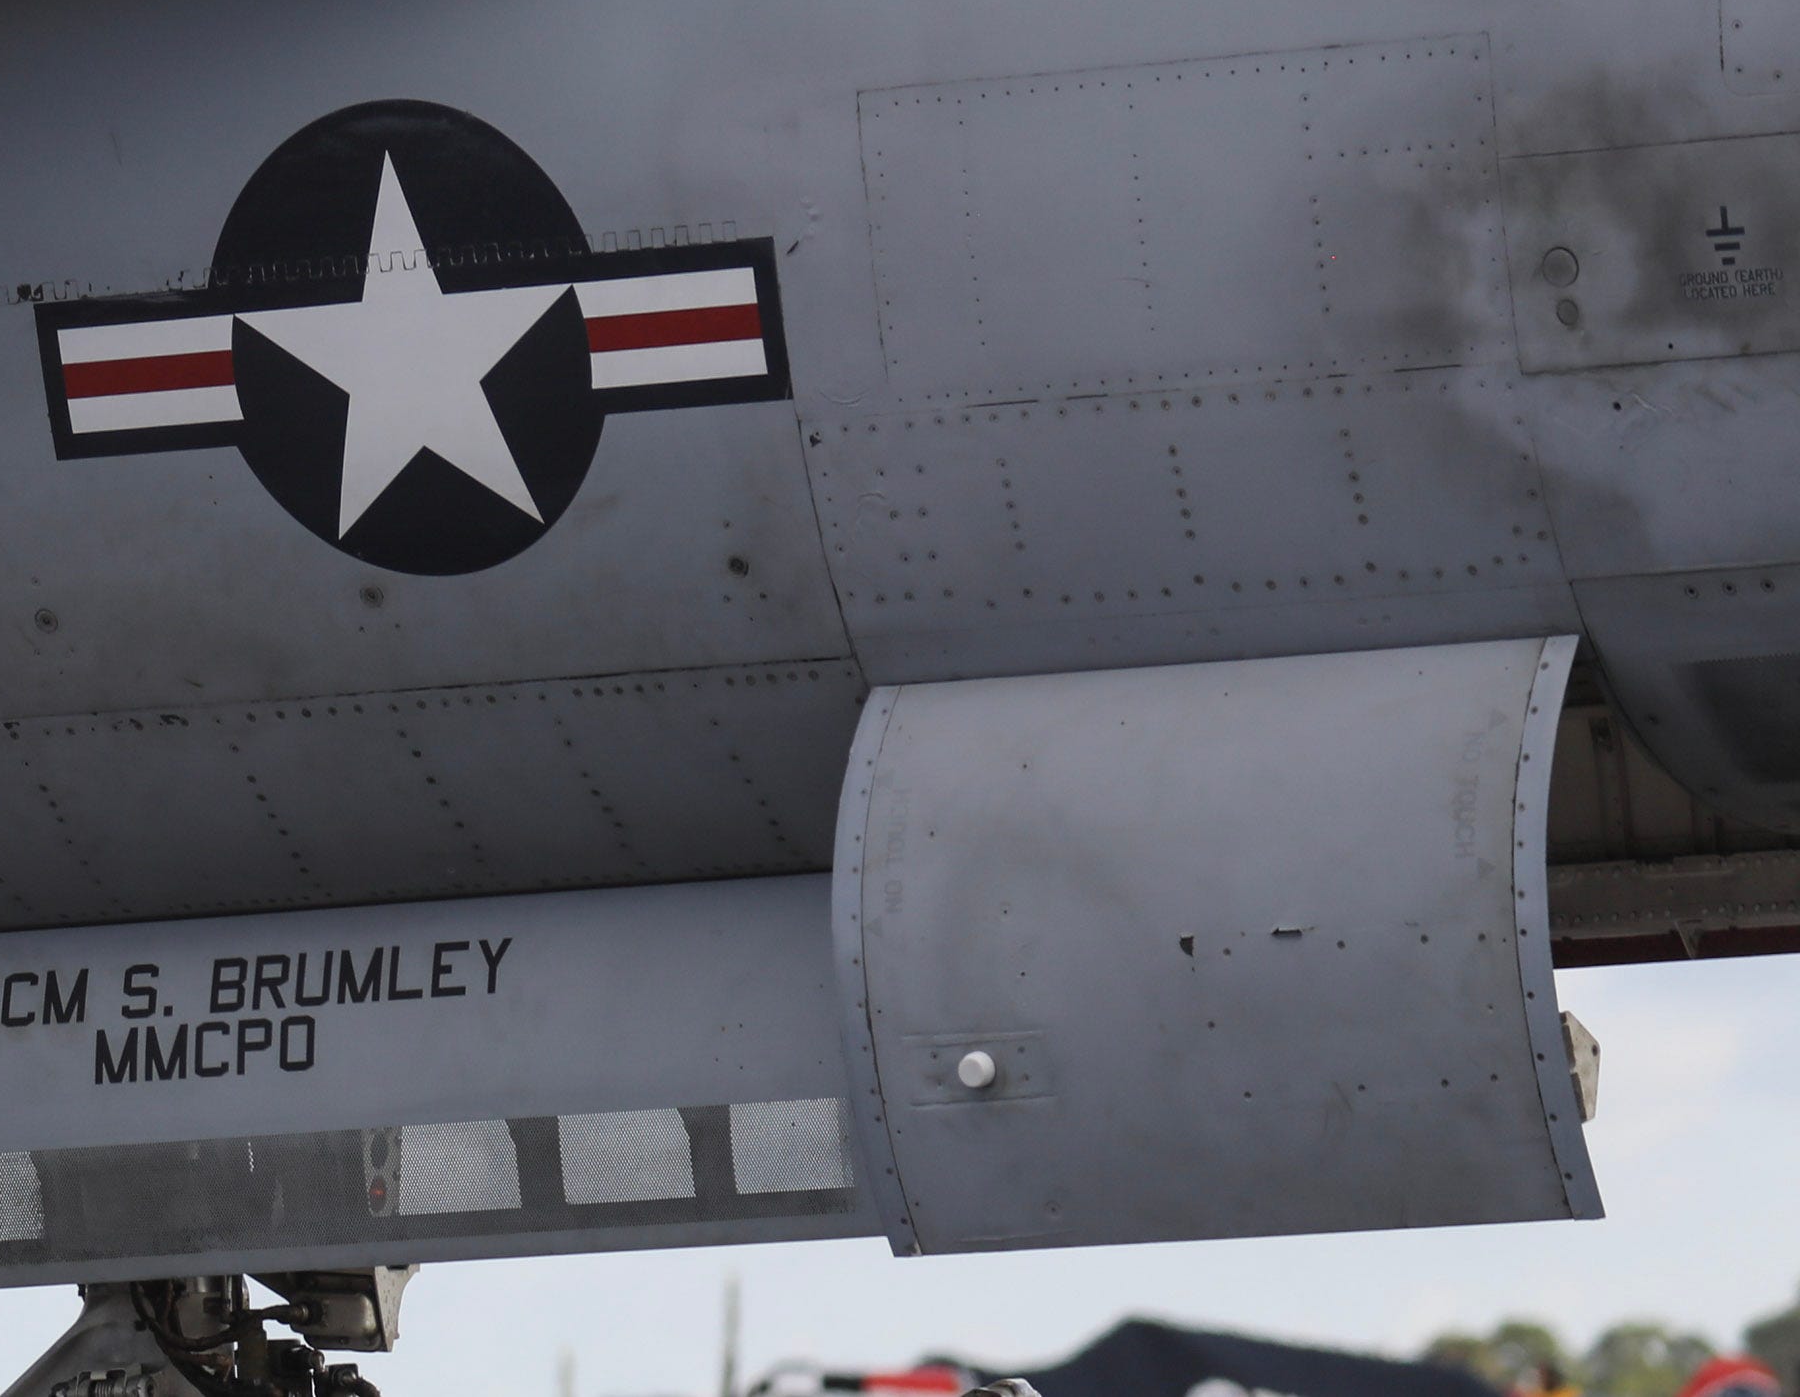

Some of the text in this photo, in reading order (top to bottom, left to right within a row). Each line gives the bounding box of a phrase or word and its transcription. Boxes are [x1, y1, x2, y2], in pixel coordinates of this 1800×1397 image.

[1680, 270, 1729, 286] GROUND
[1684, 283, 1776, 300] LOCATED HERE
[121, 964, 174, 1019] S.
[210, 938, 513, 1013] BRUMLEY
[94, 1015, 315, 1085] MMCPO
